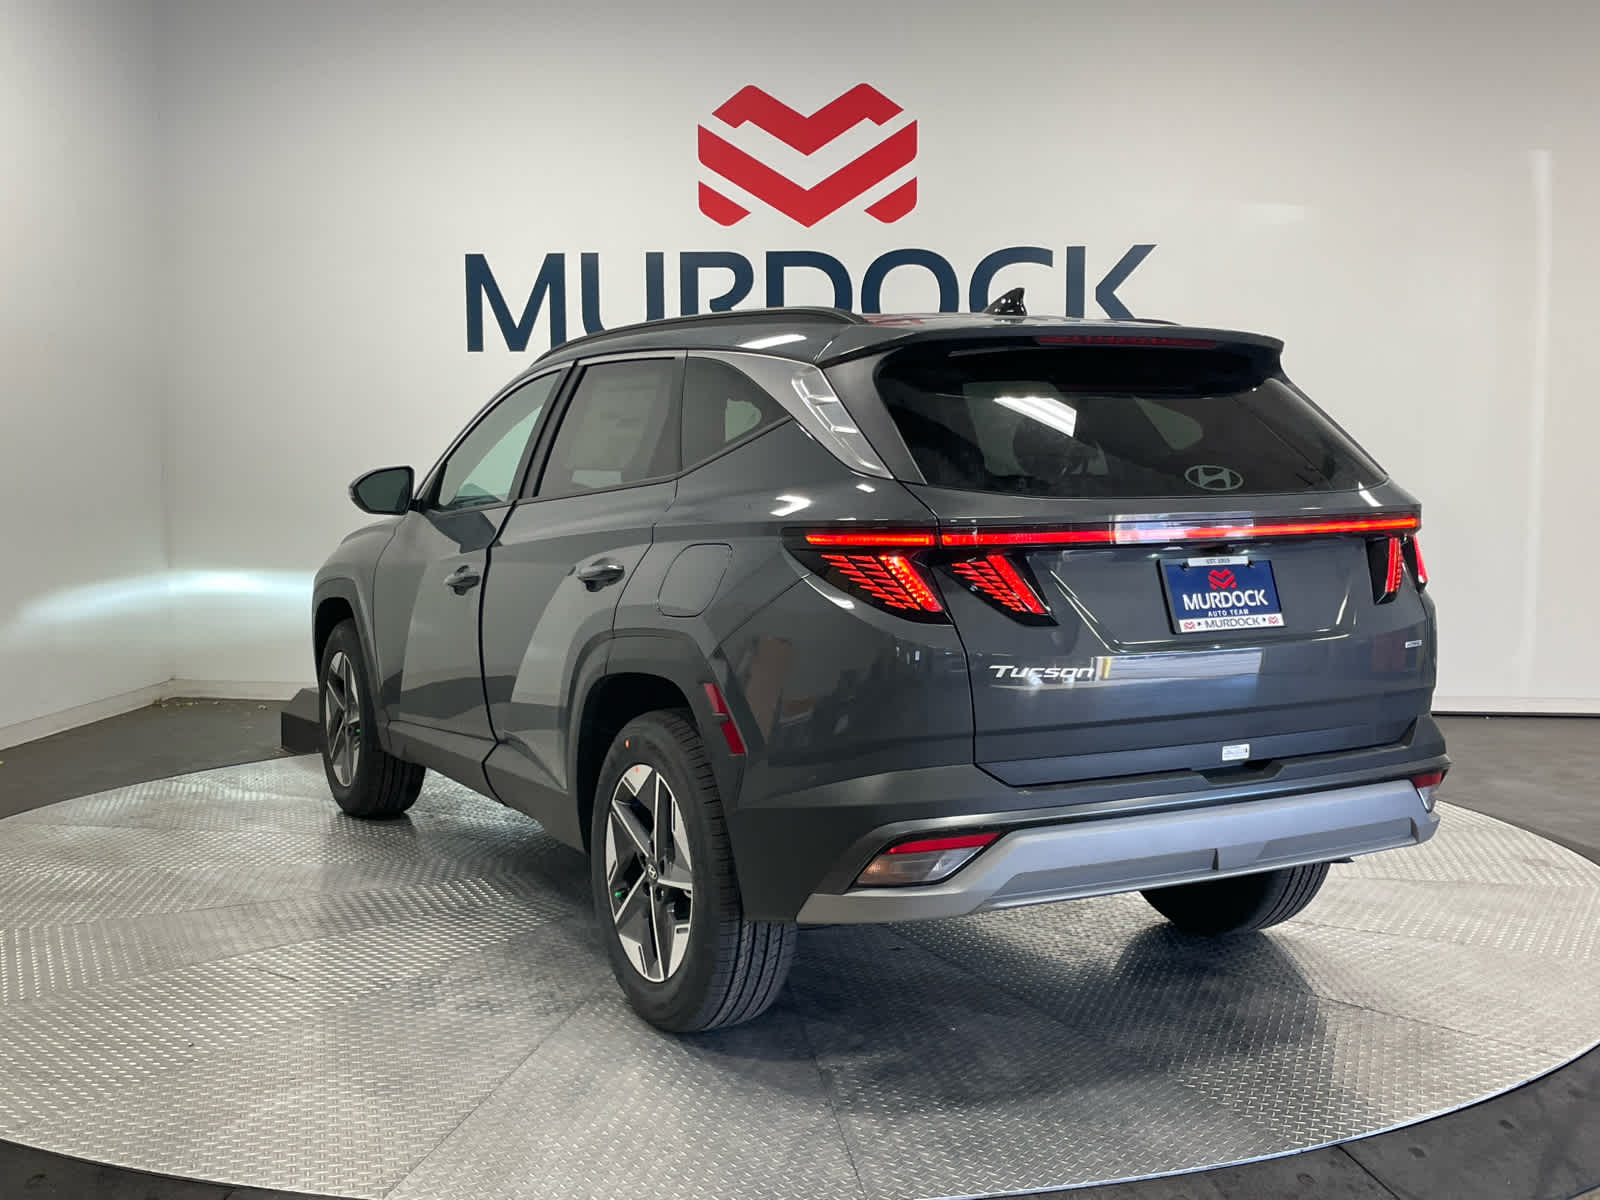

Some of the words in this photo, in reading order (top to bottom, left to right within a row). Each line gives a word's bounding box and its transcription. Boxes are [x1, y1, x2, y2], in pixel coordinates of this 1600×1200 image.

[464, 243, 1157, 352] MURDOCK
[1182, 589, 1269, 611] MURDOCK
[1204, 617, 1260, 629] MURDOCK
[989, 665, 1095, 679] Tucson
